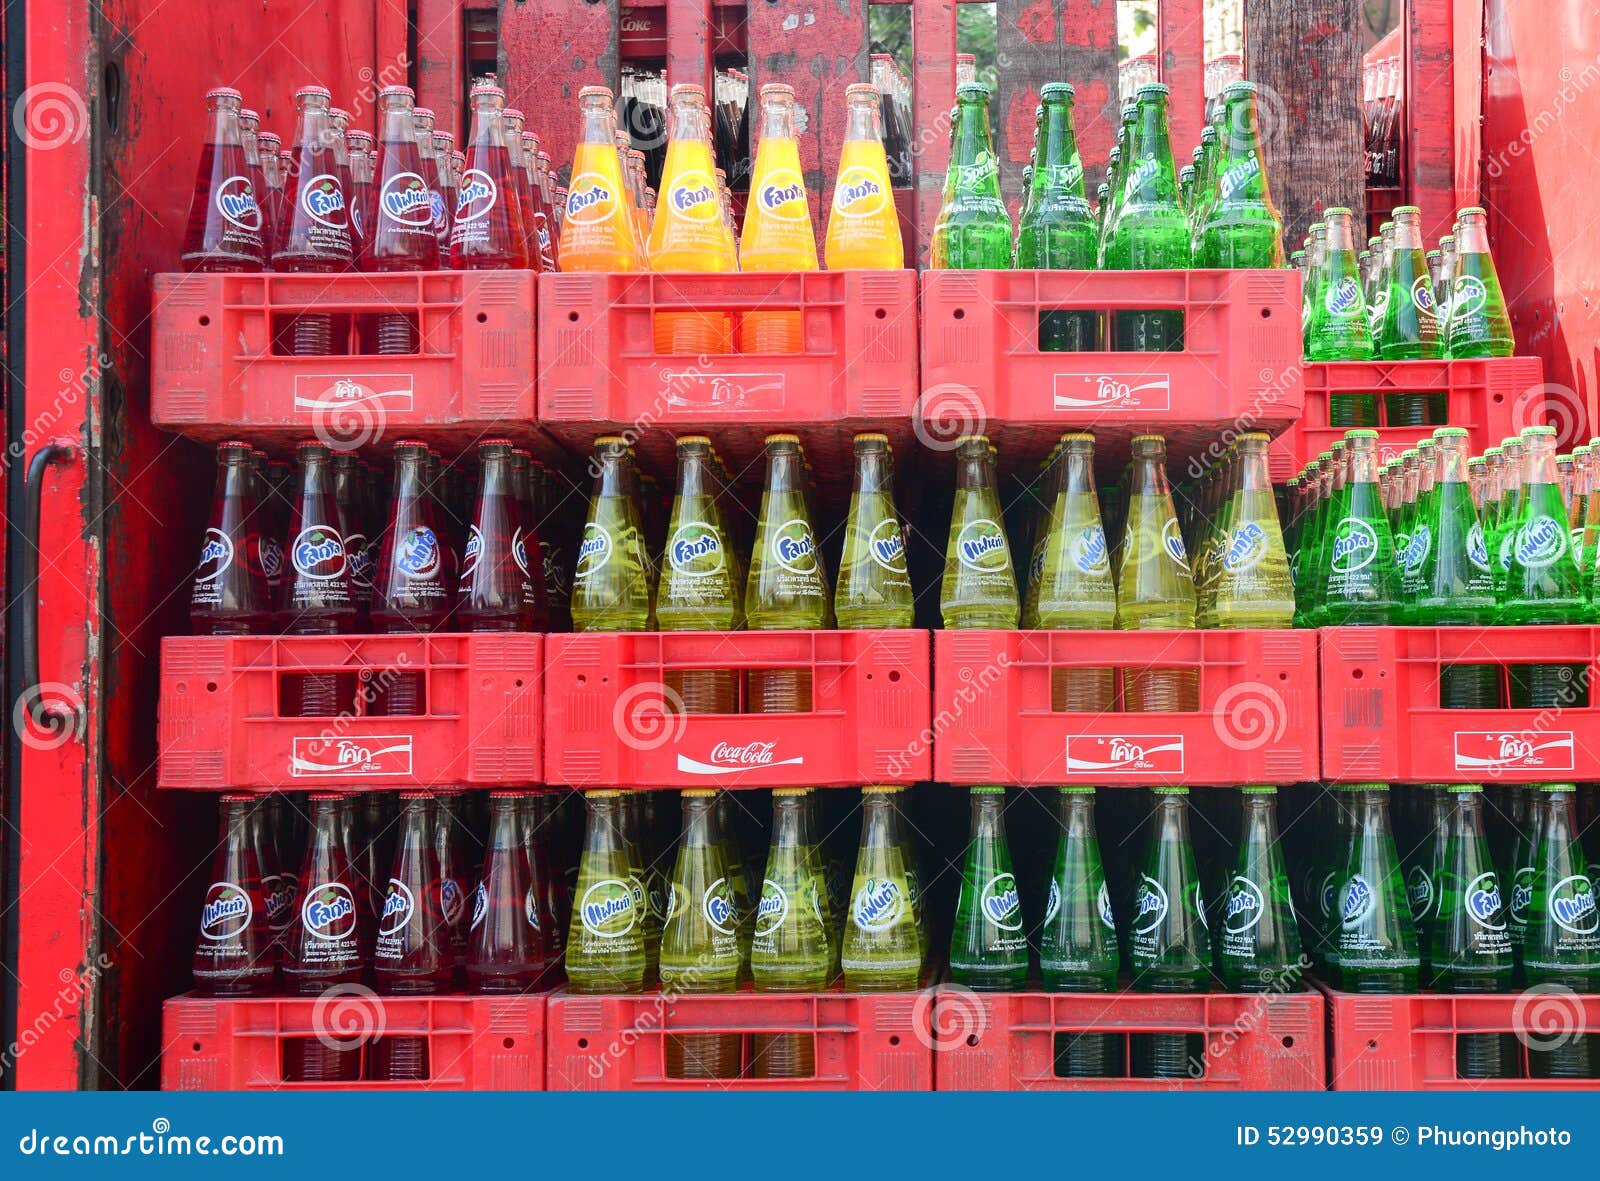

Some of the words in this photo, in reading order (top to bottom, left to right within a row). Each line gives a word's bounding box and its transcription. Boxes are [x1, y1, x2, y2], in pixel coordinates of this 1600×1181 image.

[568, 186, 610, 217] Fanta
[673, 185, 715, 211] Fanta
[763, 183, 804, 208] Fanta
[838, 179, 880, 208] Fanta
[297, 539, 342, 569] Fanta
[398, 528, 436, 576] Fanta
[674, 536, 717, 564] Fanta
[309, 897, 353, 928] Fanta
[857, 882, 899, 927] แฟนต้า
